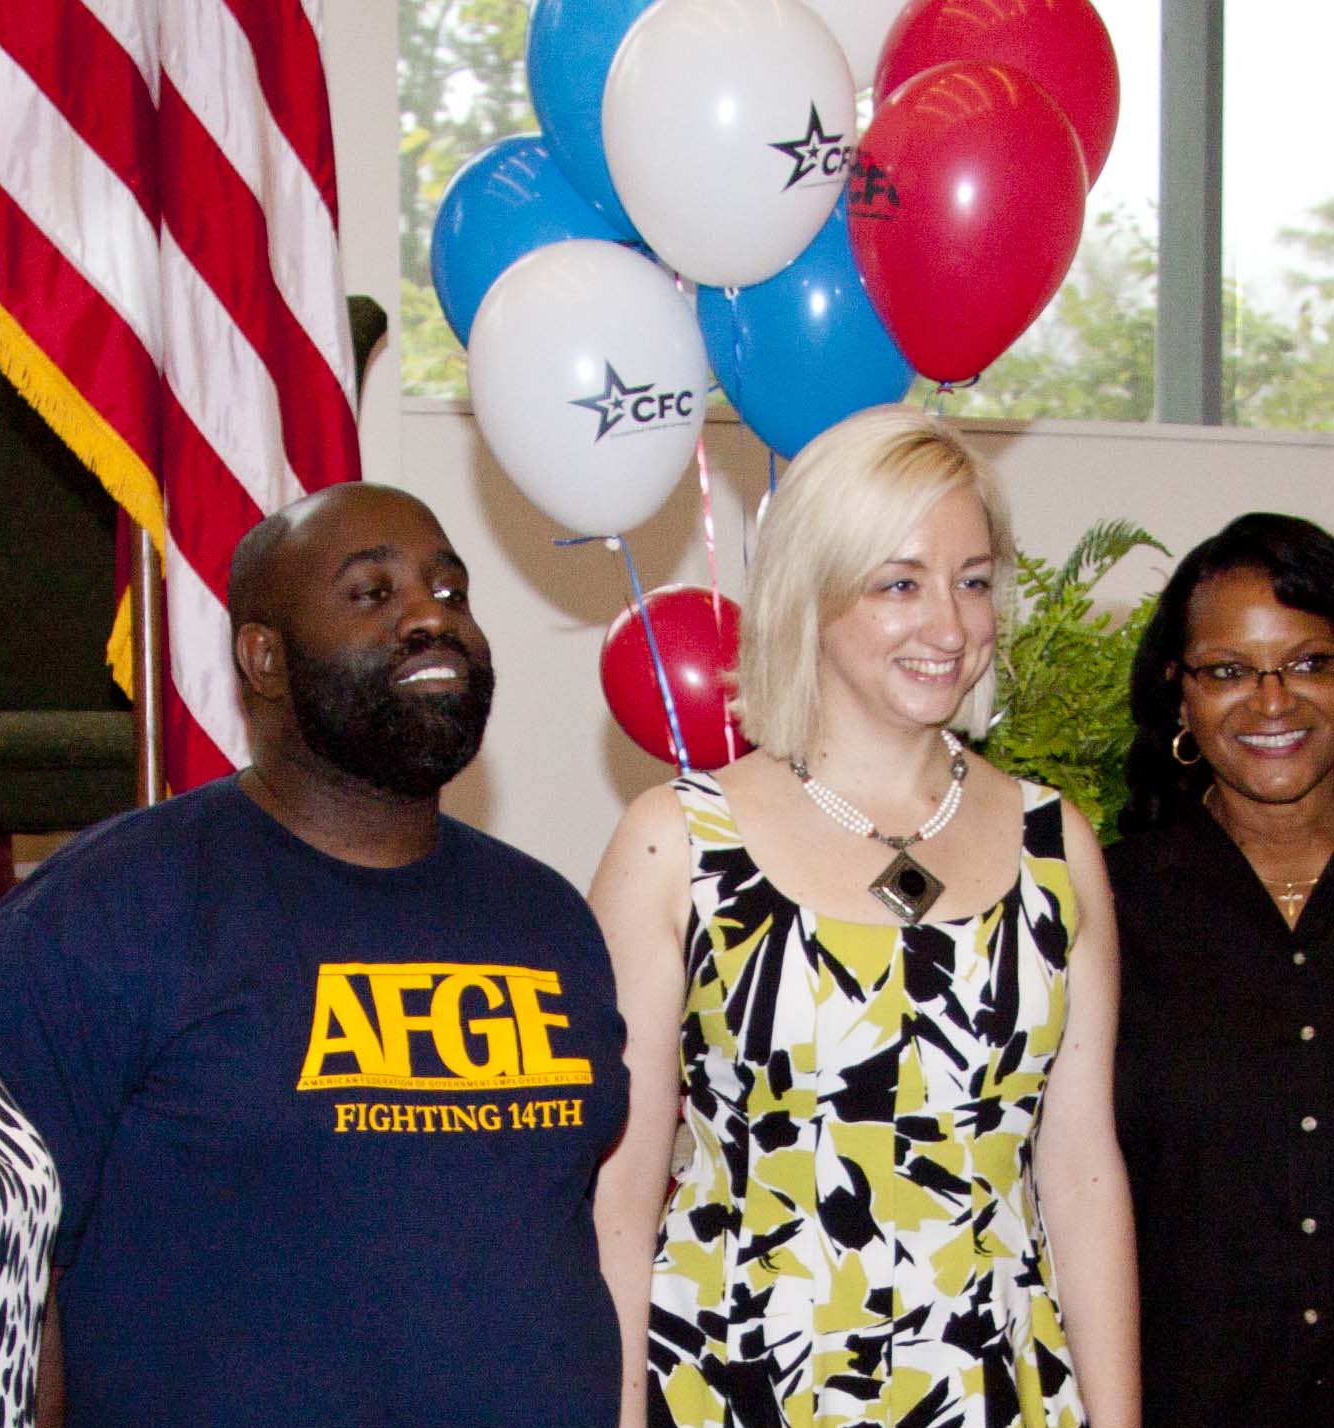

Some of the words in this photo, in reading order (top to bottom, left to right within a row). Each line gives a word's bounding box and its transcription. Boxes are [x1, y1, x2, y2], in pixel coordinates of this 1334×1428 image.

[630, 389, 693, 423] CFC
[299, 963, 593, 1082] AFGE
[334, 1103, 501, 1132] FIGHTING
[506, 1099, 583, 1129] 14TH
